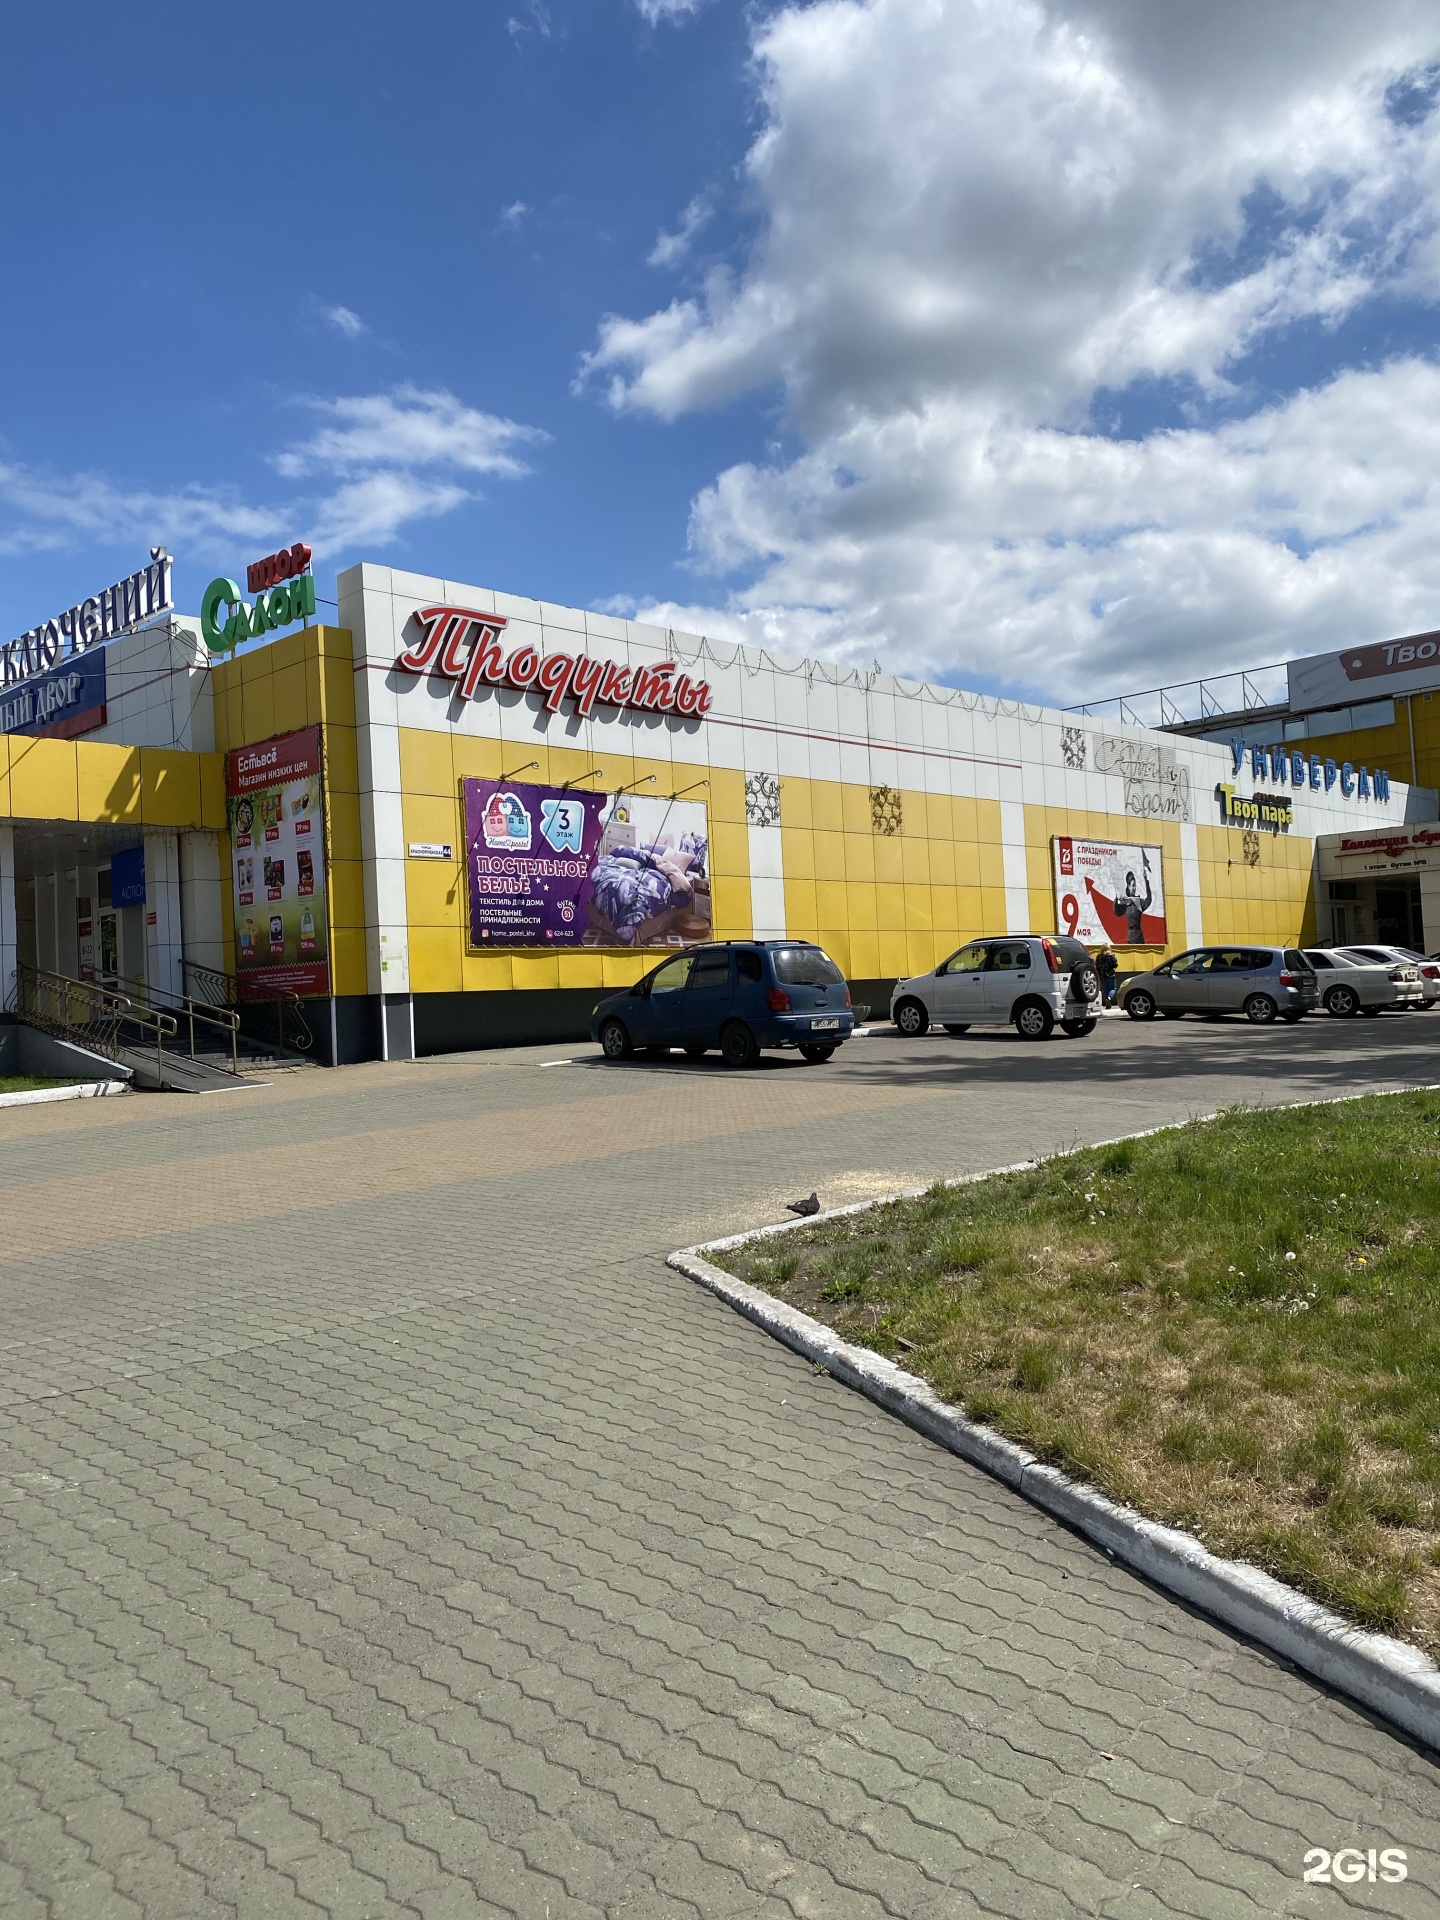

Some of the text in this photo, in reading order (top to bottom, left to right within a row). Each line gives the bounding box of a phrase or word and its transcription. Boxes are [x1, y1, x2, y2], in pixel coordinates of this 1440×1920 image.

[247, 543, 311, 593] ШТОР
[396, 604, 714, 717] Продукты
[1382, 641, 1440, 666] ТВО
[36, 672, 82, 724] ДВОР
[238, 760, 308, 788] Магазин низких цен
[1231, 737, 1390, 804] УНИВЕРСАМ
[1219, 783, 1259, 820] Твоя
[1261, 805, 1294, 829] пара
[558, 809, 569, 829] 3
[1082, 847, 1118, 856] ПРАЗДНИКОМ
[1340, 836, 1409, 852] Коллекция
[477, 855, 588, 878] ПОСТЕЛЬНОЕ
[1077, 857, 1102, 866] ПОБЕДЫ!
[480, 898, 511, 906] ТЕКСТИЛЬ
[480, 909, 522, 917] ПОСТЕЛЬНЫЕ
[1062, 894, 1079, 937] 9
